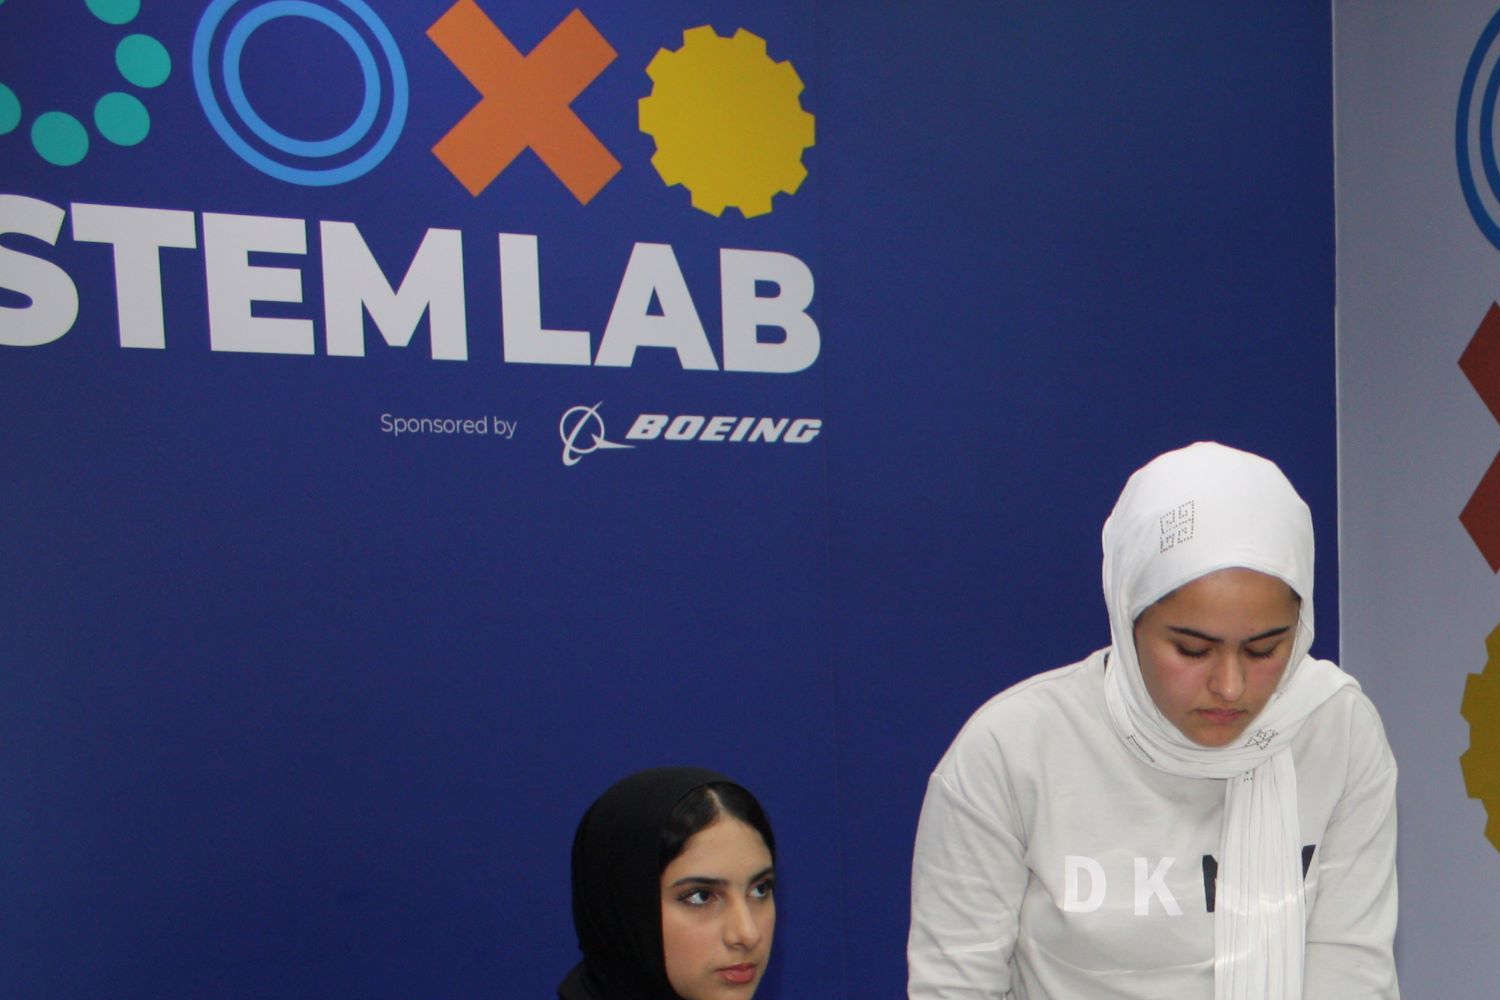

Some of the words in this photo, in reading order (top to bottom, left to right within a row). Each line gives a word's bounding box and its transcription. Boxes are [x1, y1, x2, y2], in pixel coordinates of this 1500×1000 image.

[0, 193, 469, 362] STEM
[498, 232, 822, 374] LAB
[380, 413, 489, 437] Sponsored
[494, 416, 517, 440] by
[625, 413, 823, 444] BOEING
